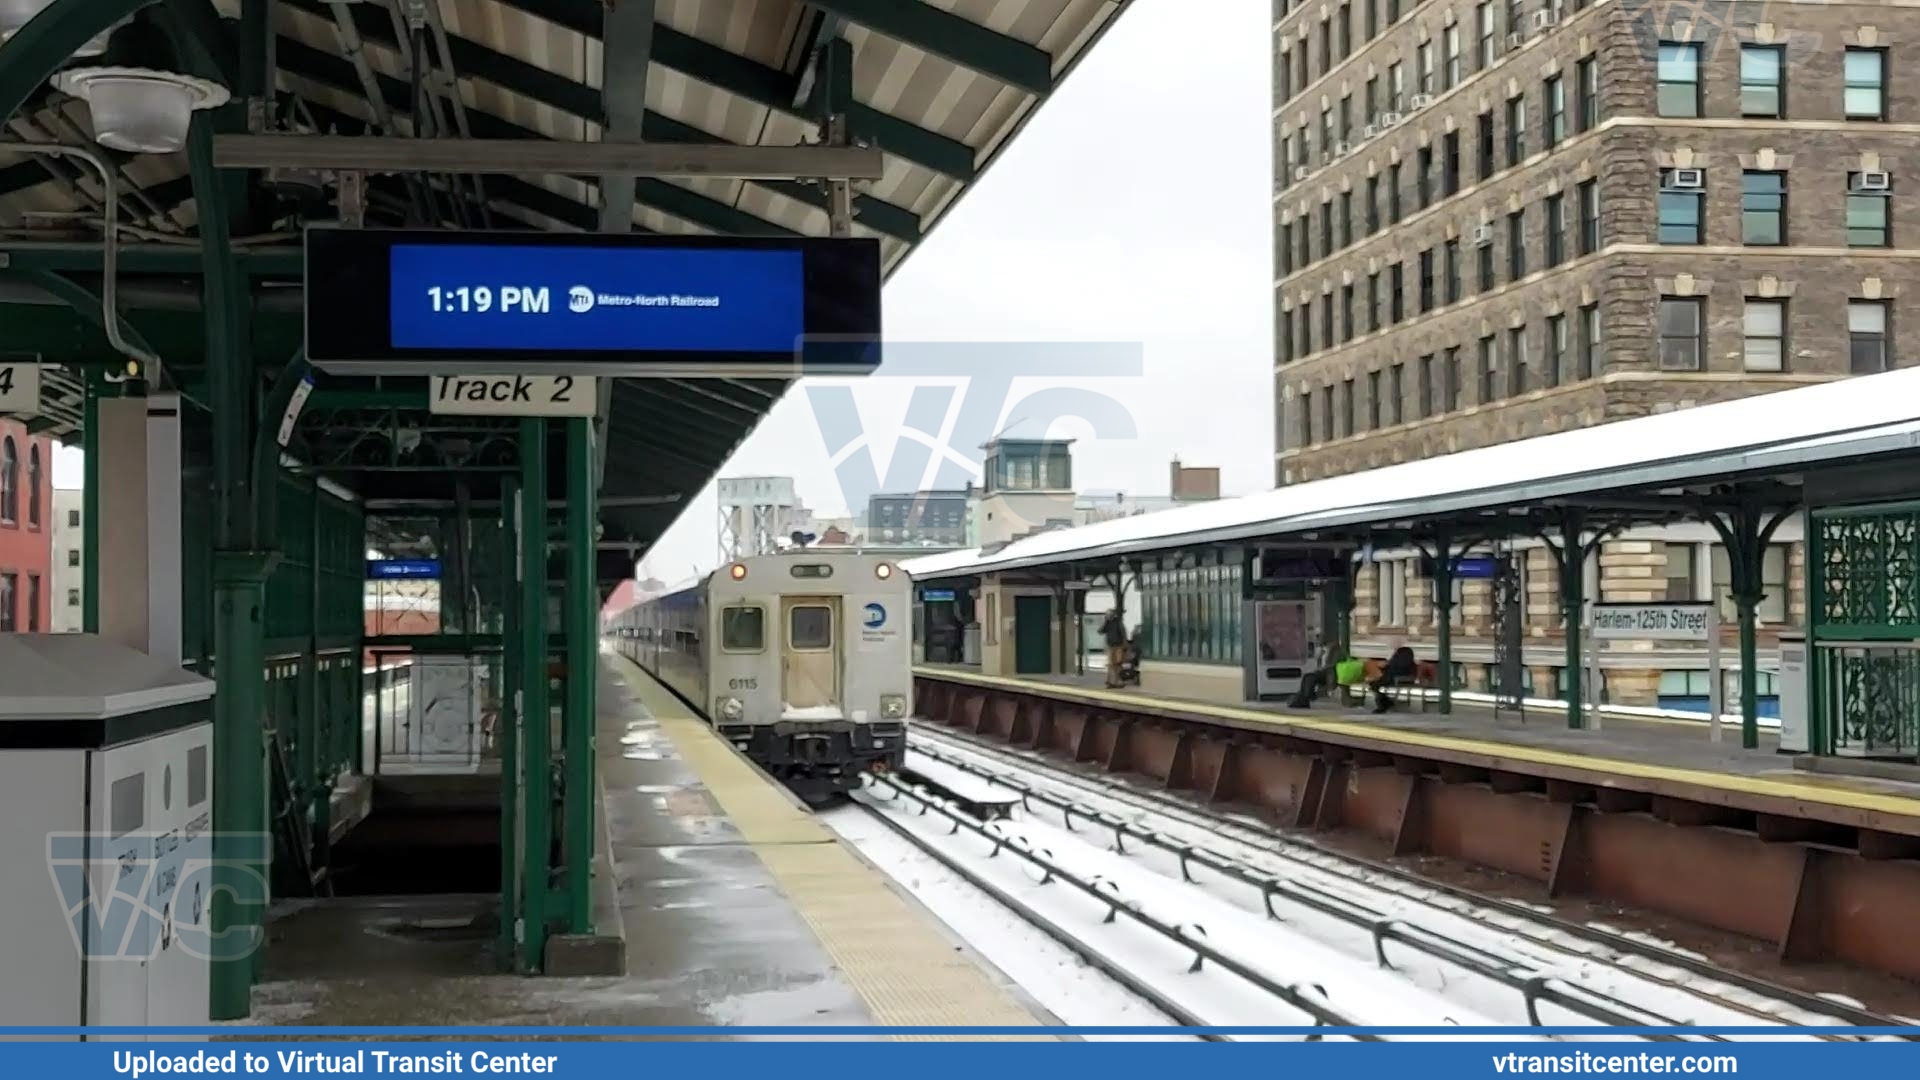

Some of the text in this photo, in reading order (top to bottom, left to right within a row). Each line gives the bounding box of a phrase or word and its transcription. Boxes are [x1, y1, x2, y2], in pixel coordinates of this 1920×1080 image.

[428, 286, 492, 312] 1:19
[501, 286, 550, 313] PM
[598, 294, 669, 306] Metro-North
[671, 294, 719, 306] Railroad
[436, 374, 574, 402] Track 2
[1594, 608, 1707, 630] Harlem-125th Street
[728, 678, 758, 690] 6115
